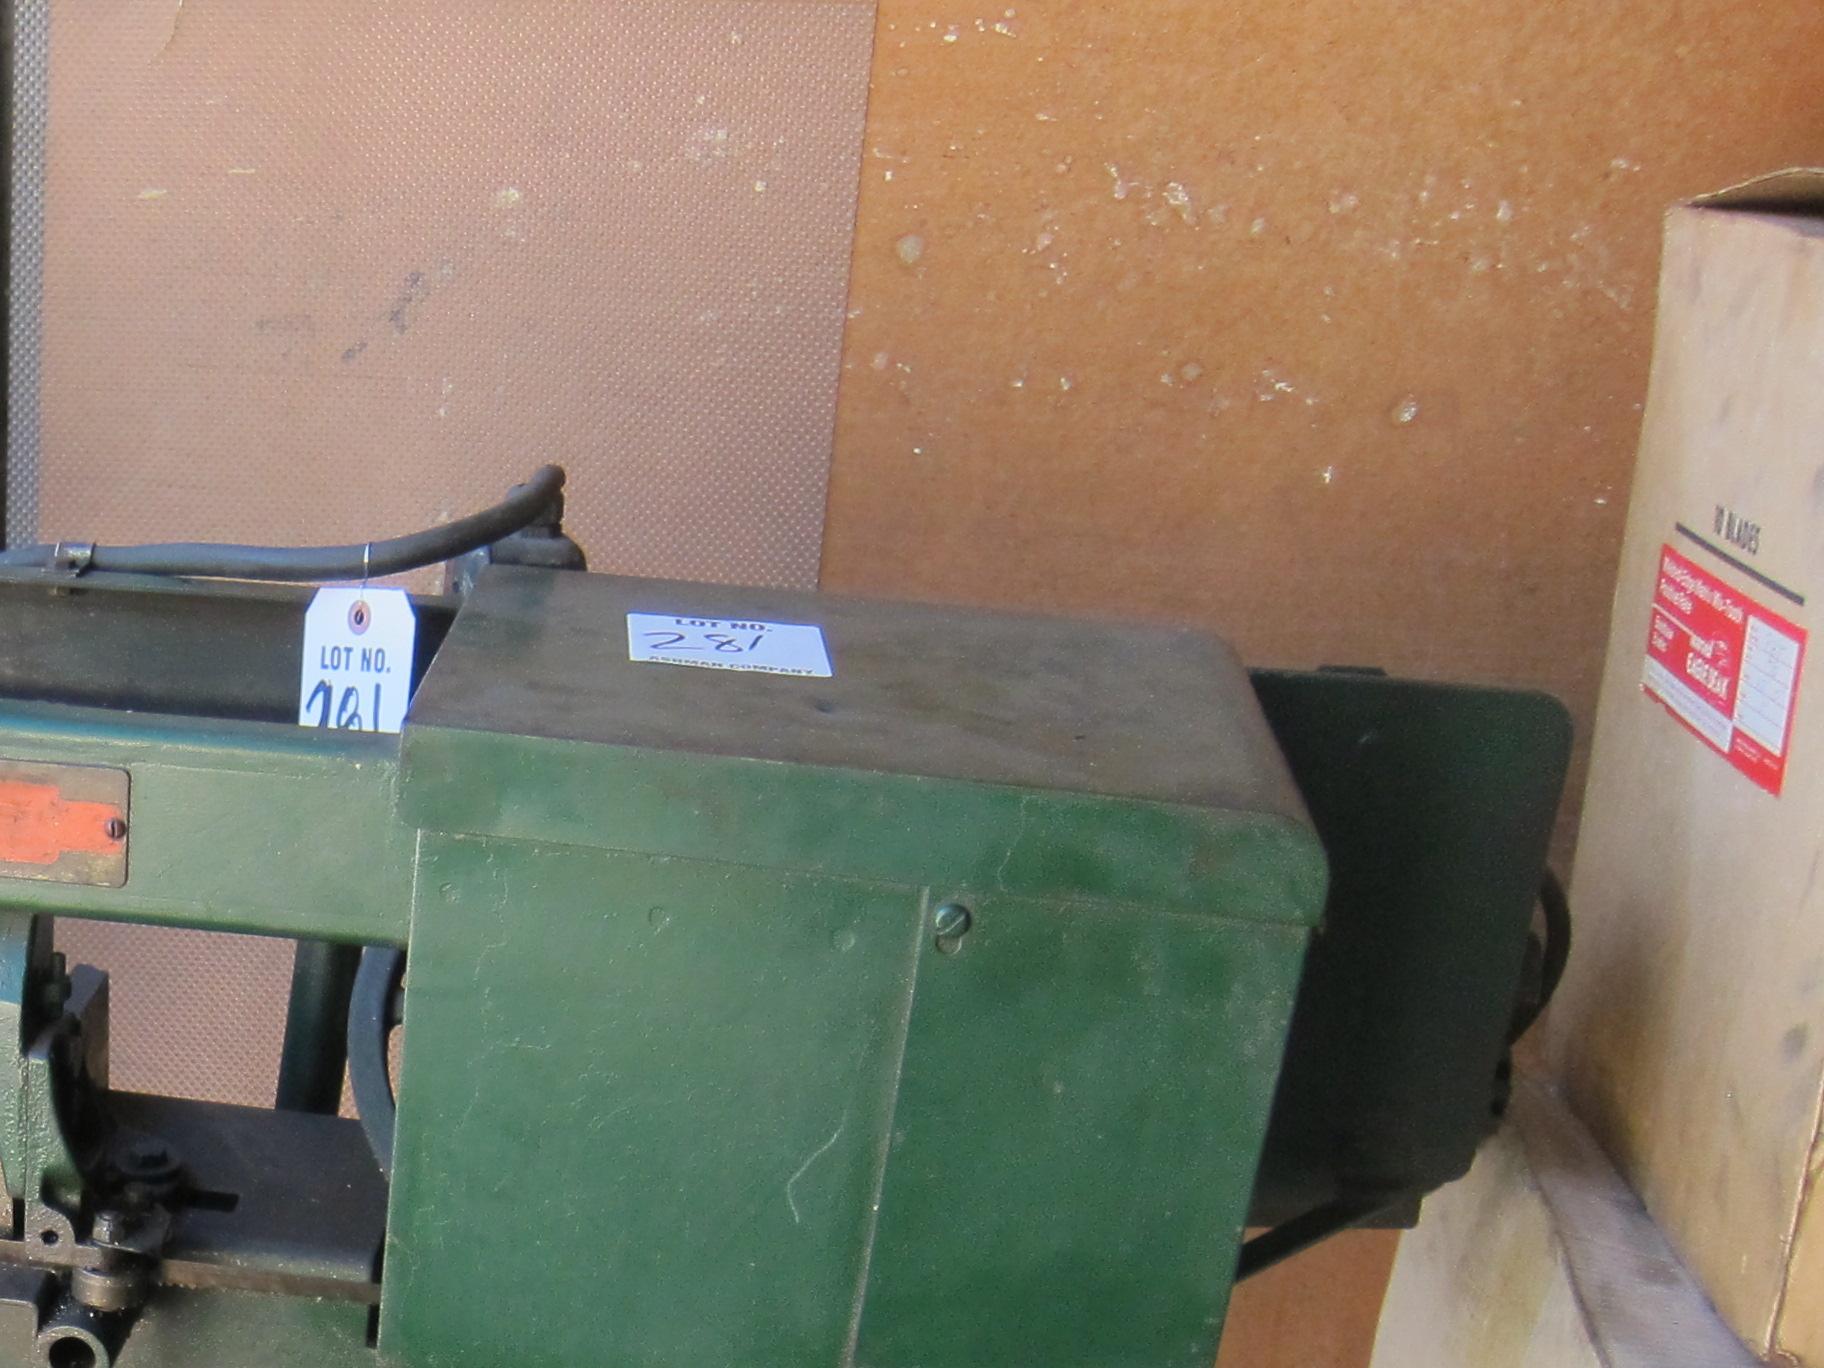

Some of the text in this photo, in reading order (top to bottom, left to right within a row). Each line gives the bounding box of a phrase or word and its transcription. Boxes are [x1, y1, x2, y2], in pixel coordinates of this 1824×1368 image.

[674, 618, 773, 632] LOT NO.
[642, 632, 764, 653] 281
[320, 645, 391, 674] LOT NO.
